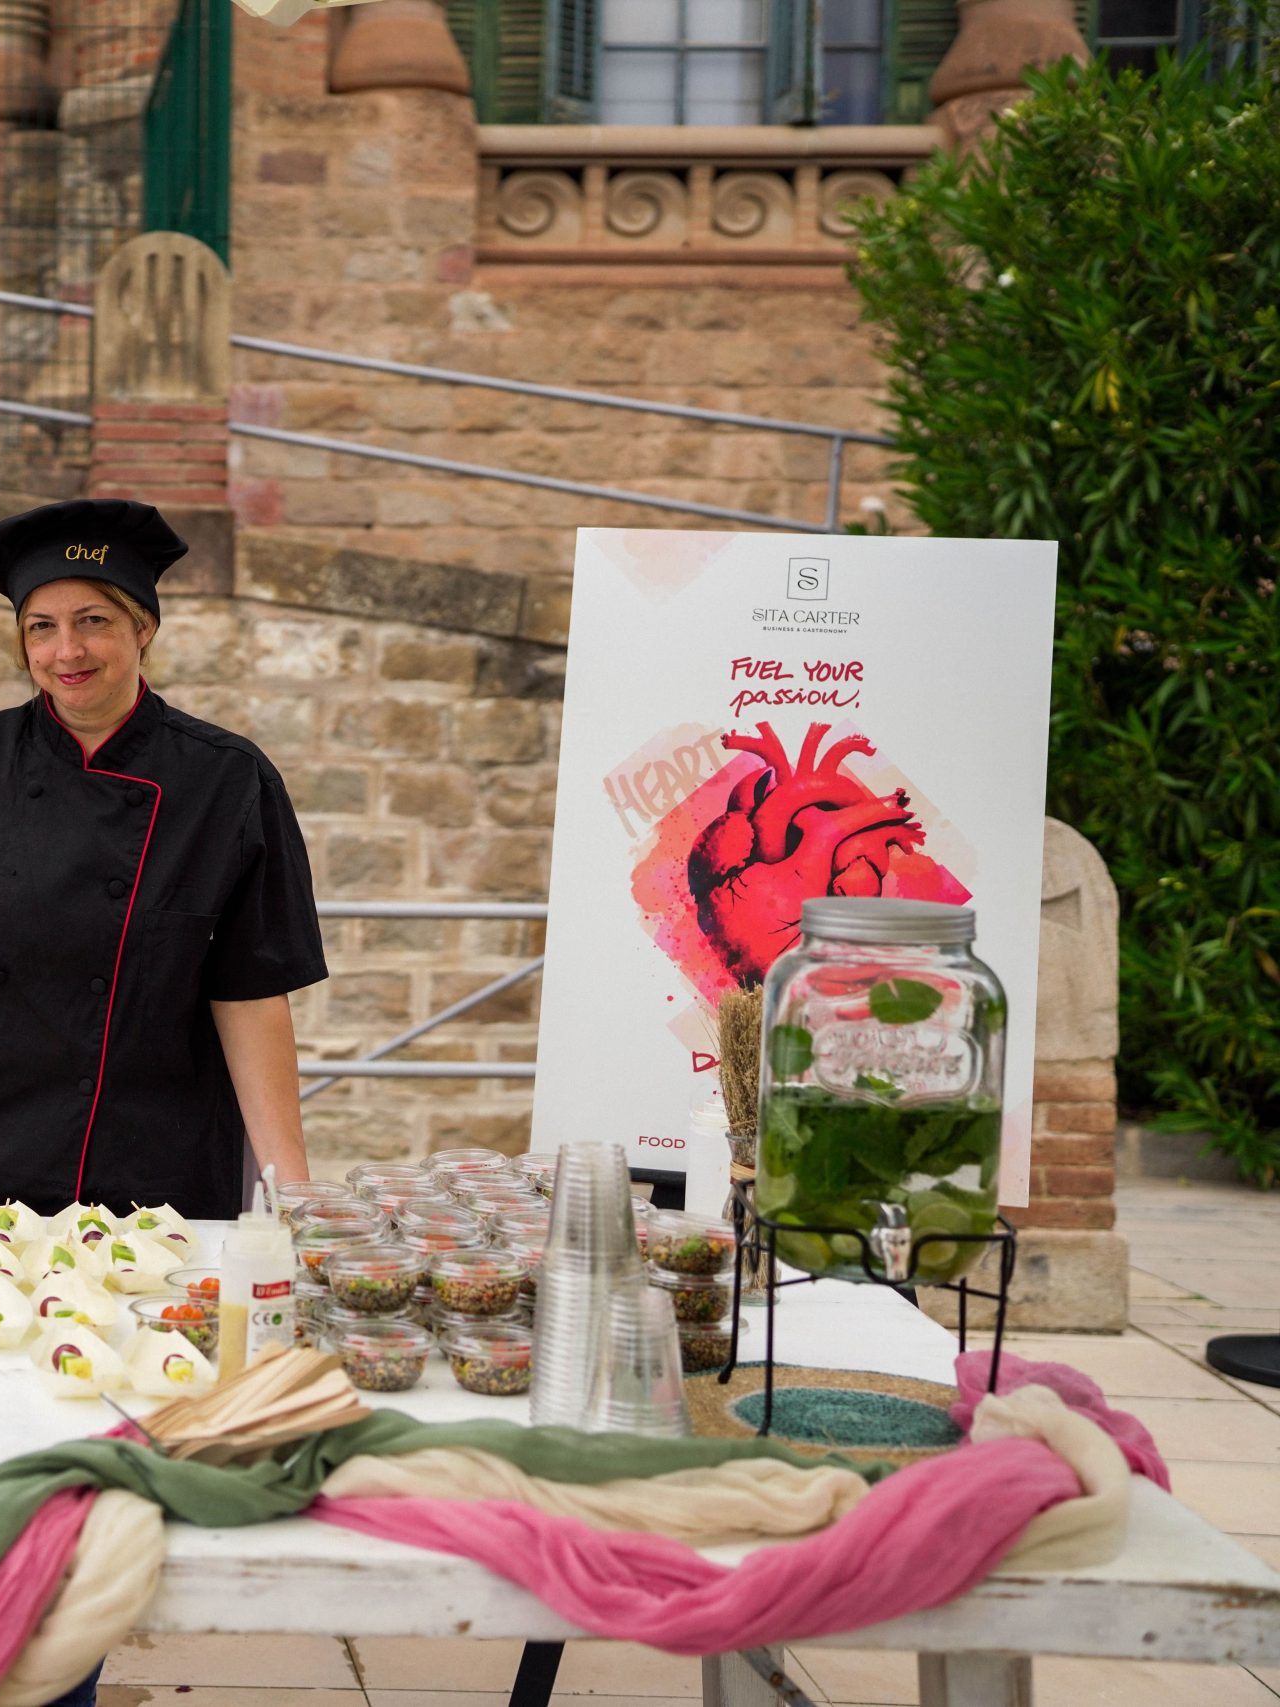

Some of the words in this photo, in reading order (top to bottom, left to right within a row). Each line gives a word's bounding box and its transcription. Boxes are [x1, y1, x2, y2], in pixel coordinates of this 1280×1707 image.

[65, 544, 108, 564] Chef
[798, 568, 818, 590] S
[752, 608, 789, 622] SITA
[794, 610, 860, 625] CARTER
[731, 657, 794, 680] FUEL
[804, 660, 863, 682] YOUR
[730, 688, 859, 717] passion.
[603, 727, 729, 838] HEART
[639, 1136, 685, 1148] FOOD
